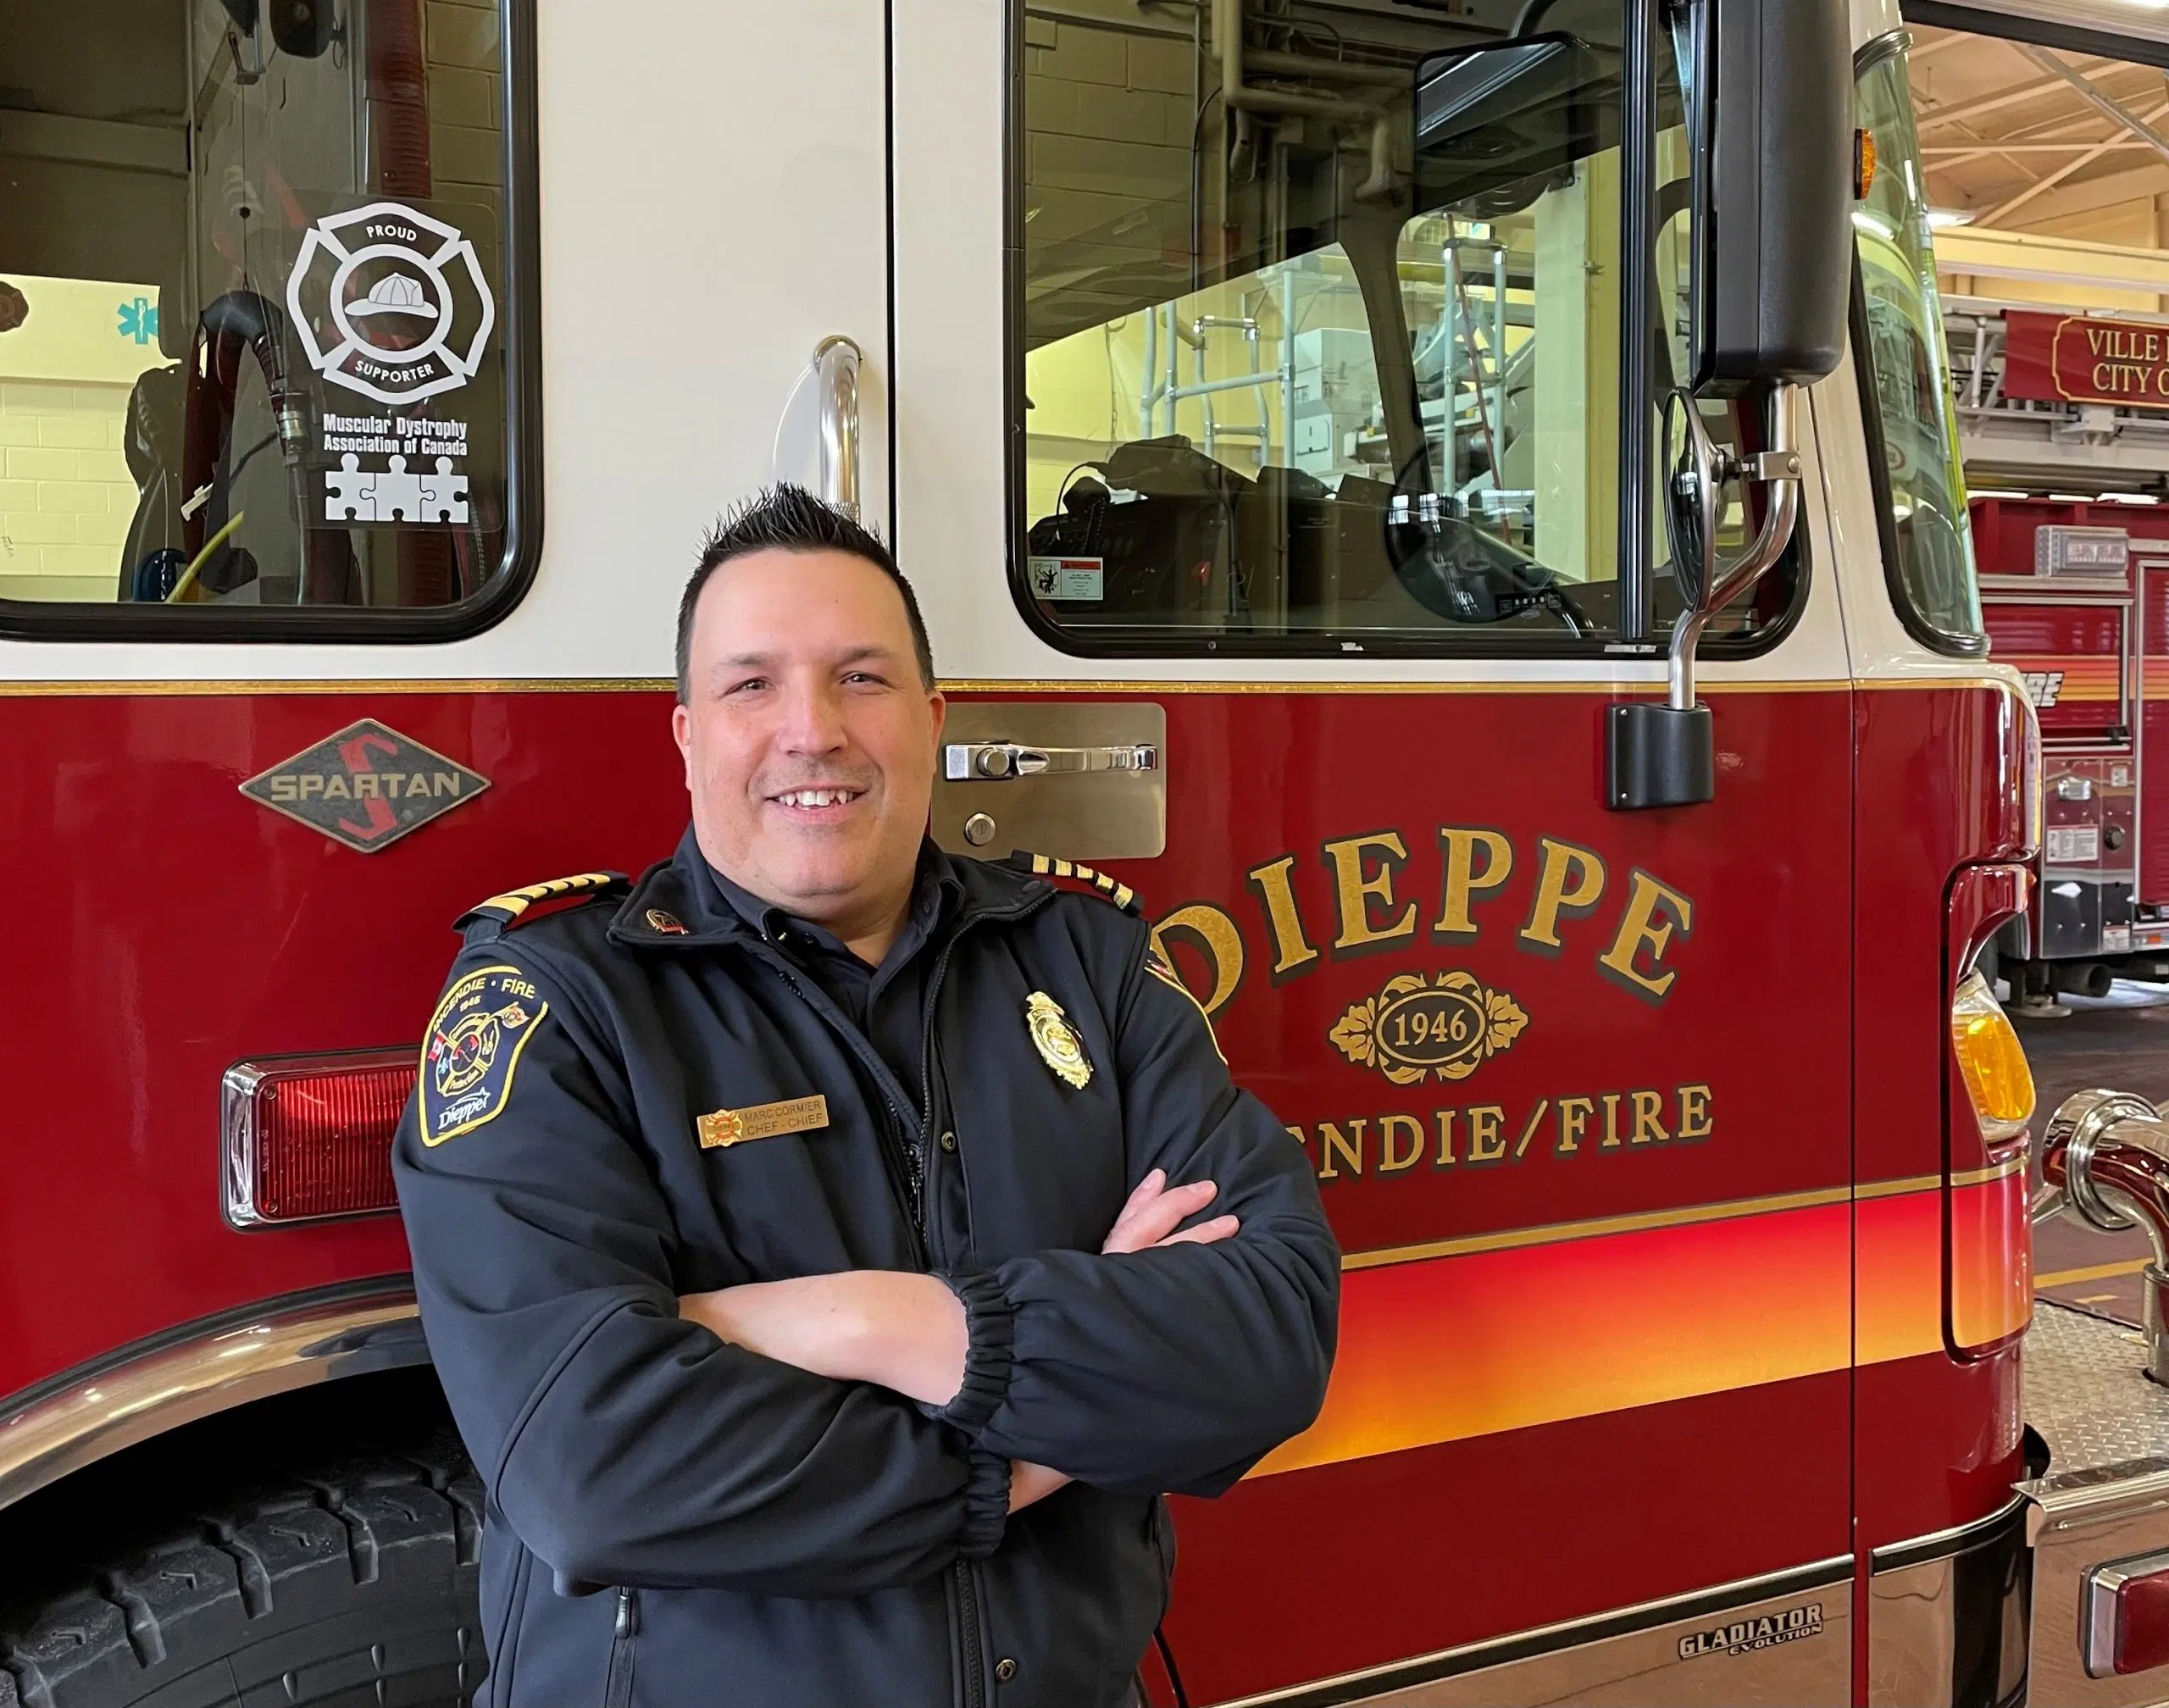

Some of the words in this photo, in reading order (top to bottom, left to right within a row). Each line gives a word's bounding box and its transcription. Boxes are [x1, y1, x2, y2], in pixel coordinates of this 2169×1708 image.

[366, 225, 417, 242] PROUD
[2086, 328, 2161, 362] VILLE
[355, 360, 434, 382] SUPPORTER
[2093, 363, 2153, 394] CITY
[323, 413, 391, 434] Muscular
[396, 417, 468, 441] Dystrophy
[324, 435, 400, 454] Association
[403, 437, 418, 454] of
[421, 436, 468, 456] Canada
[2022, 673, 2064, 707] RE
[270, 771, 460, 801] SPARTAN
[1150, 827, 1692, 1015] DIEPPE
[501, 978, 536, 1000] FIRE
[1394, 1010, 1468, 1047] 1946
[745, 1109, 774, 1123] MARC
[775, 1101, 821, 1117] CORMIER
[746, 1121, 779, 1136] CHEF
[788, 1112, 823, 1128] CHIEF
[1285, 1084, 1714, 1178] NDIE/FIRE
[1679, 1604, 1822, 1657] GLADIATOR
